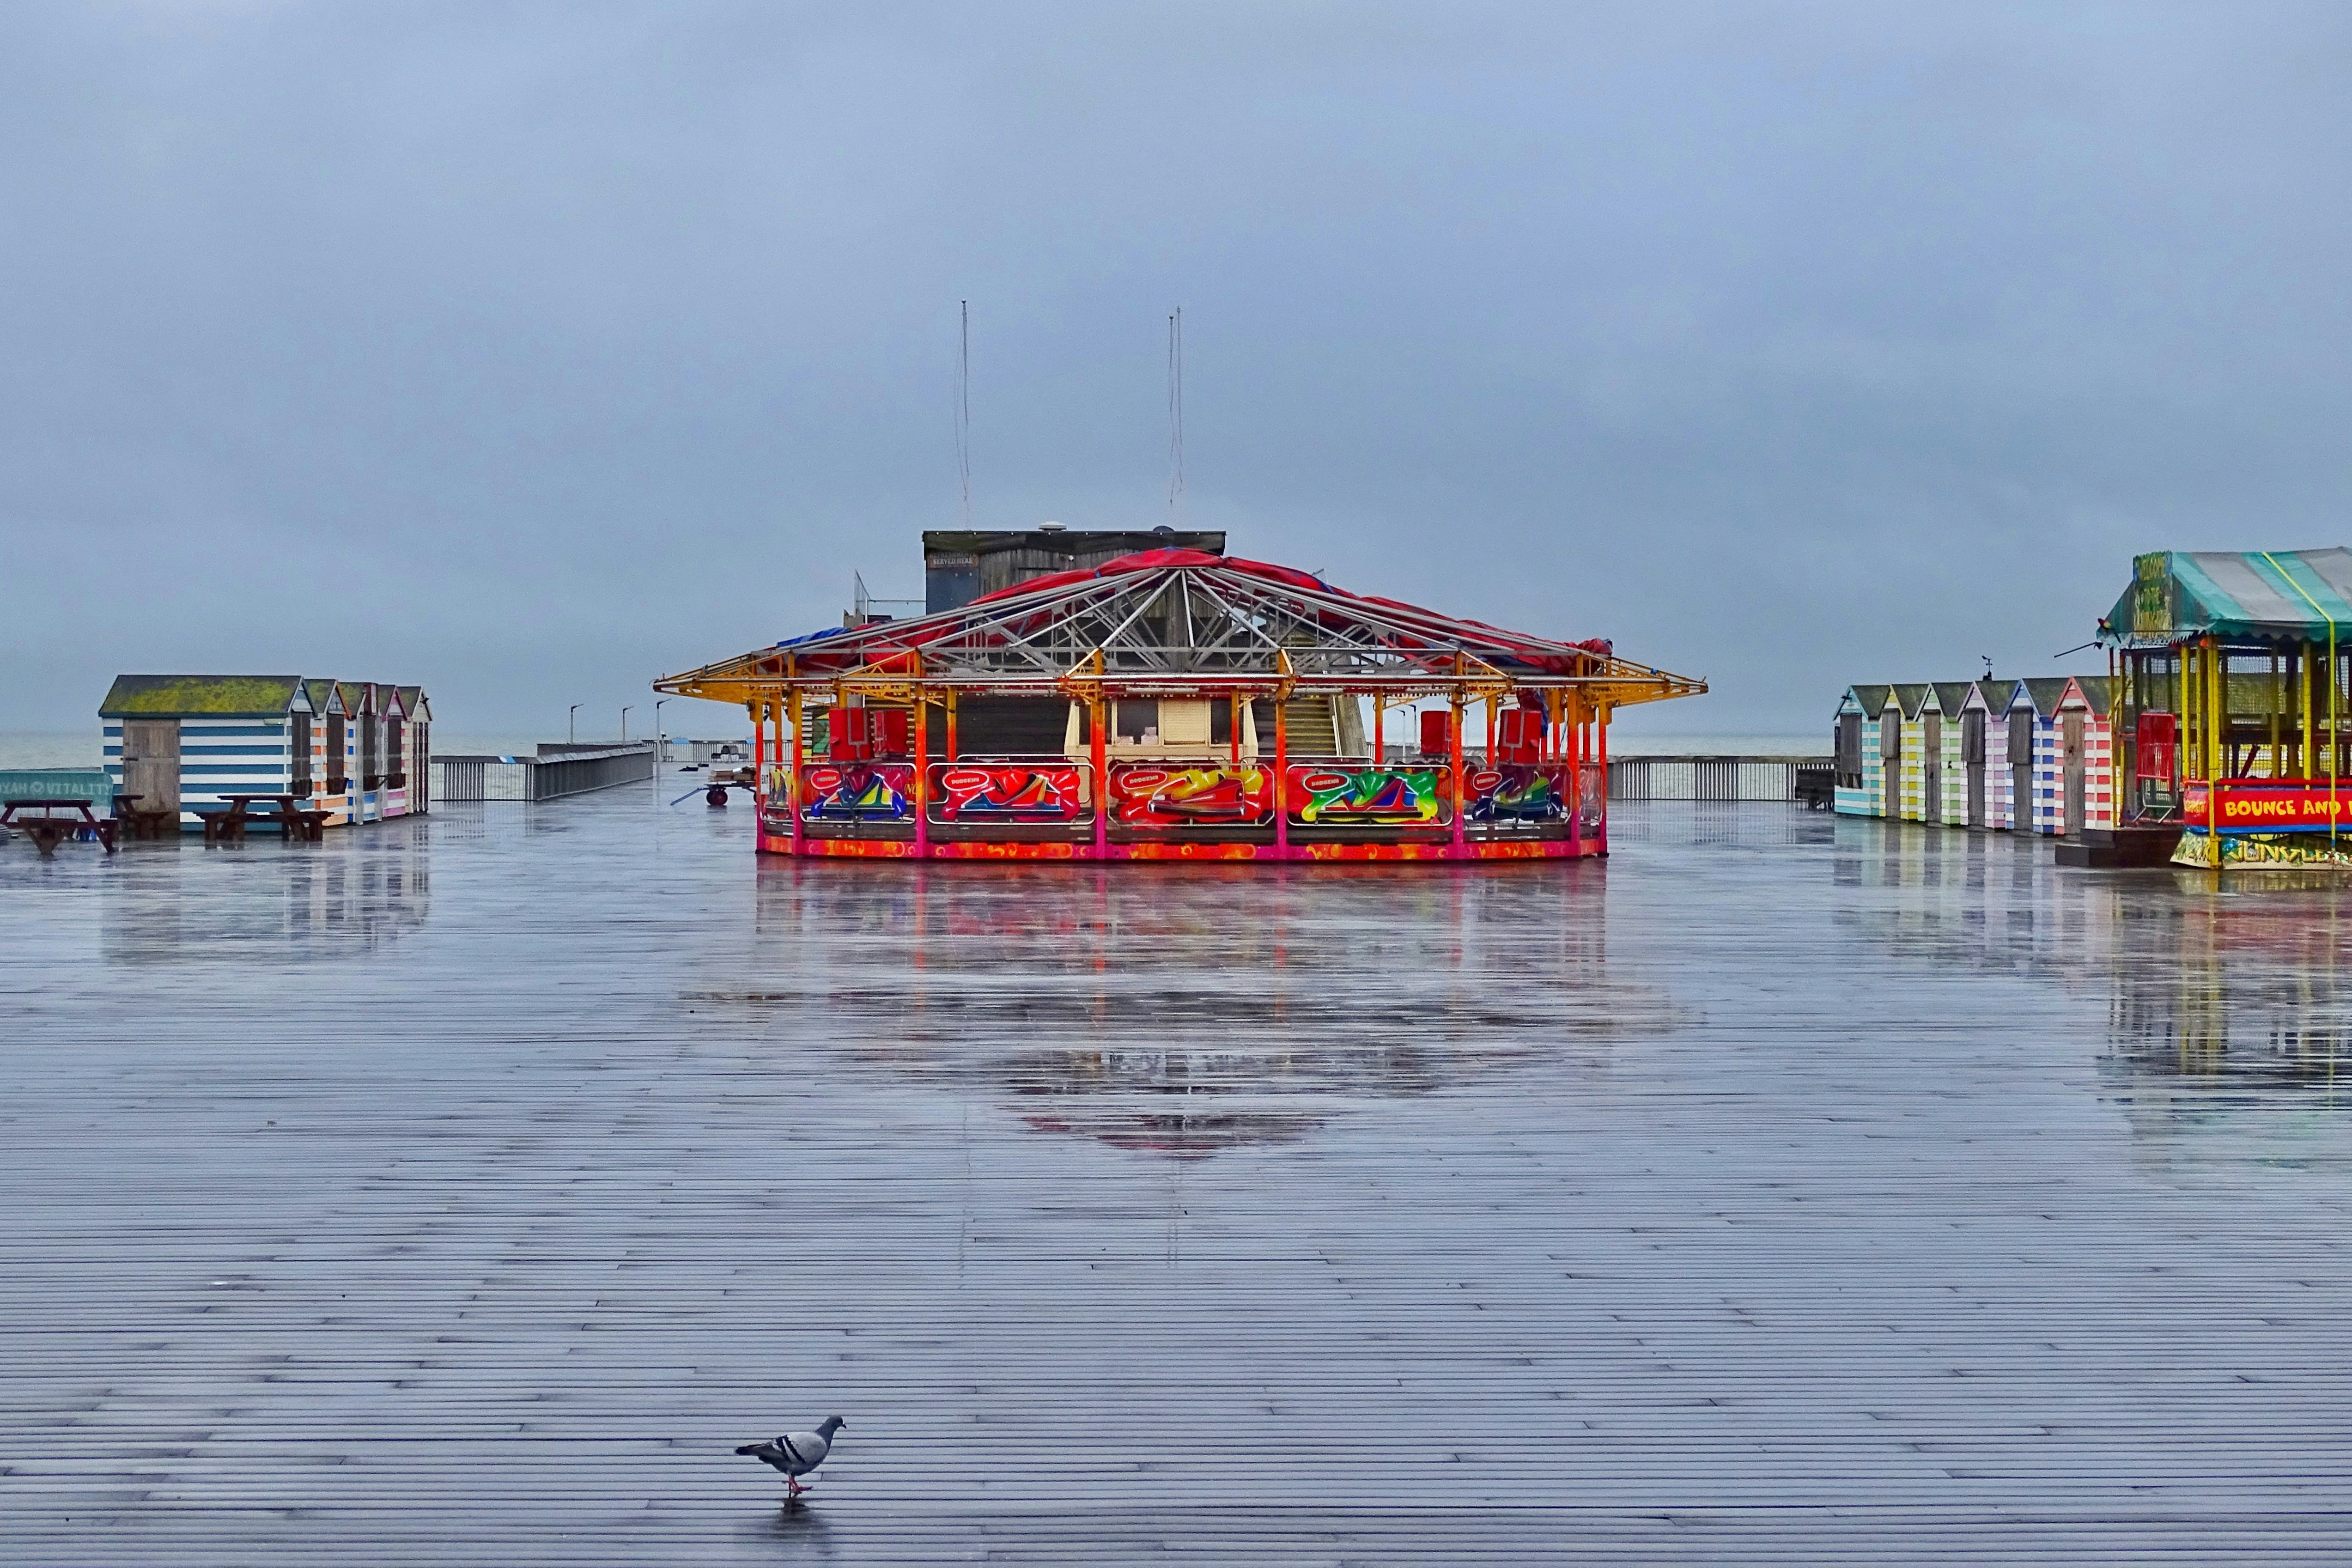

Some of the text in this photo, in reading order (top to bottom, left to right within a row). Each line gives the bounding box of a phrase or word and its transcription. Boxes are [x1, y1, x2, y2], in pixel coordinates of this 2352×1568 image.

[46, 783, 110, 795] VITALITY
[2225, 800, 2296, 816] BOUNCE
[2303, 800, 2341, 815] AND
